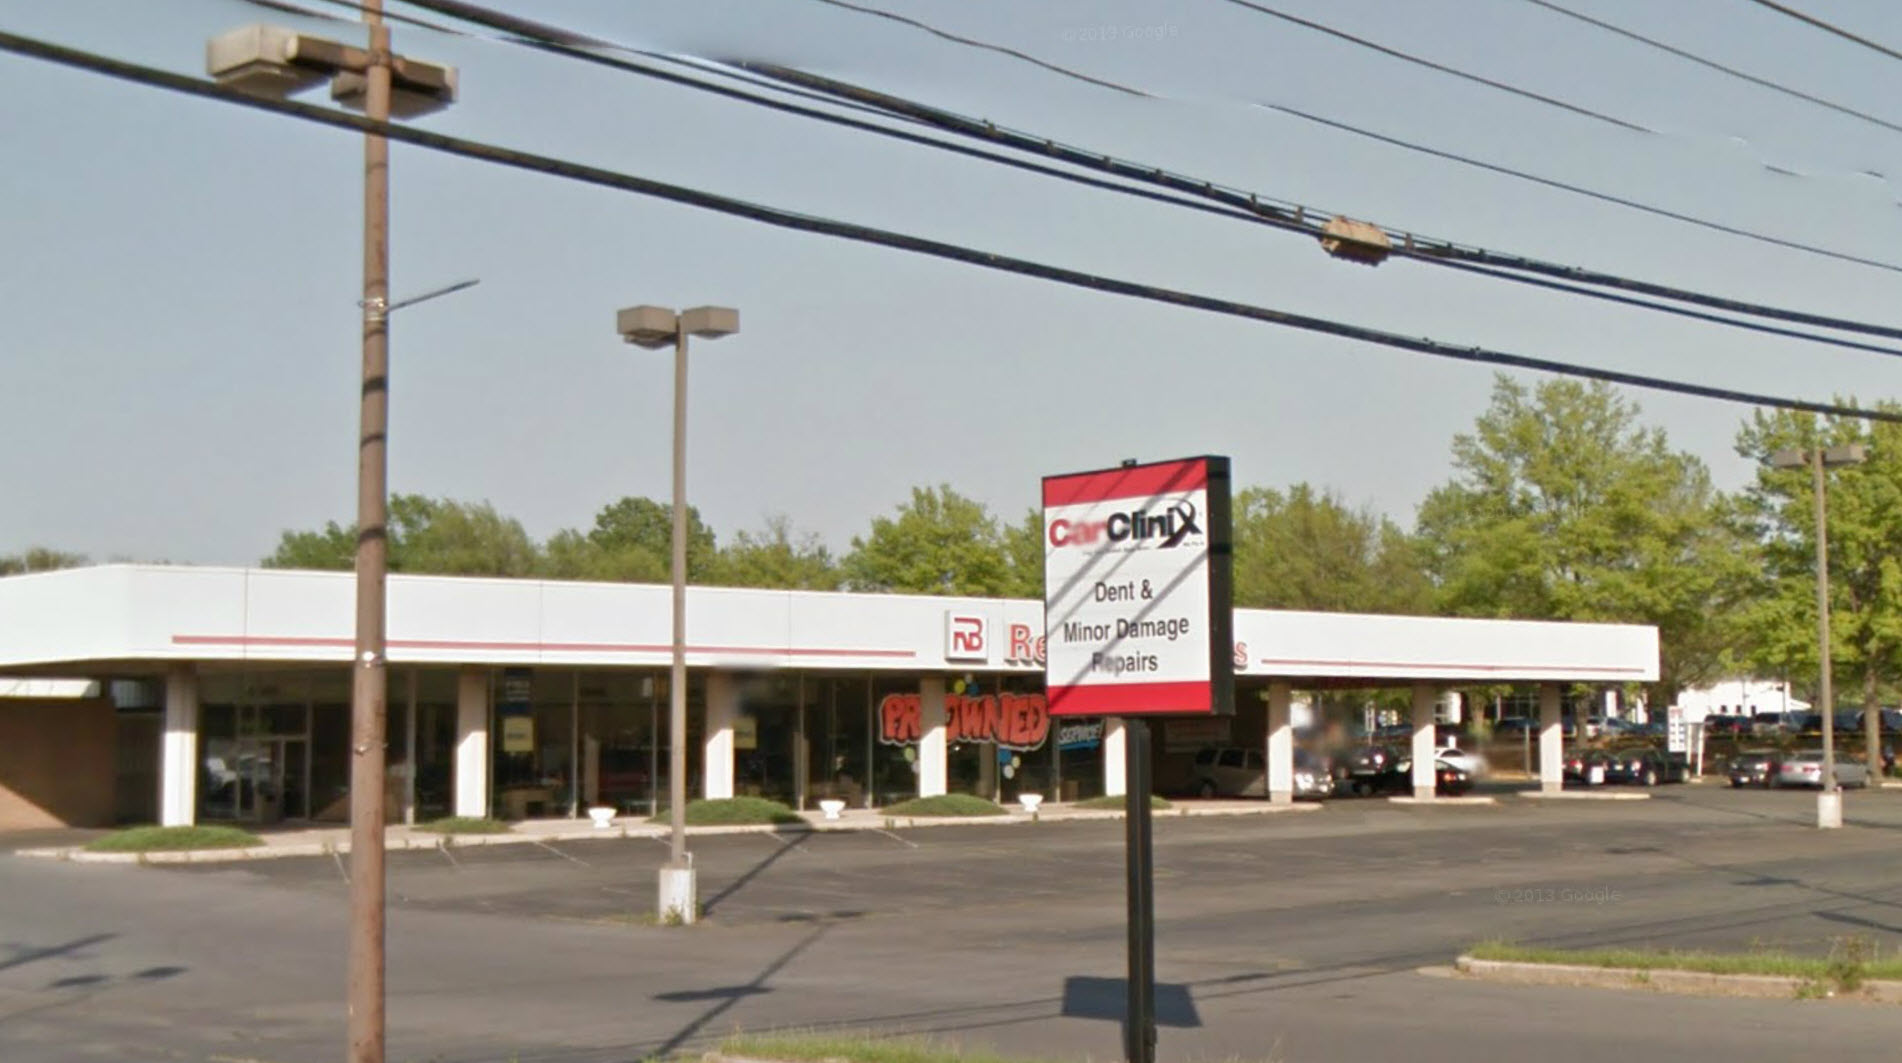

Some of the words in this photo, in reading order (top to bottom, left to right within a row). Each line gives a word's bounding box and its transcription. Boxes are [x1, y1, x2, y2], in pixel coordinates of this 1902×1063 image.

[1094, 580, 1134, 602] Dent
[1140, 579, 1153, 600] &
[1064, 621, 1111, 643] Minor
[1117, 616, 1190, 641] Damage
[1092, 650, 1158, 676] Repairs
